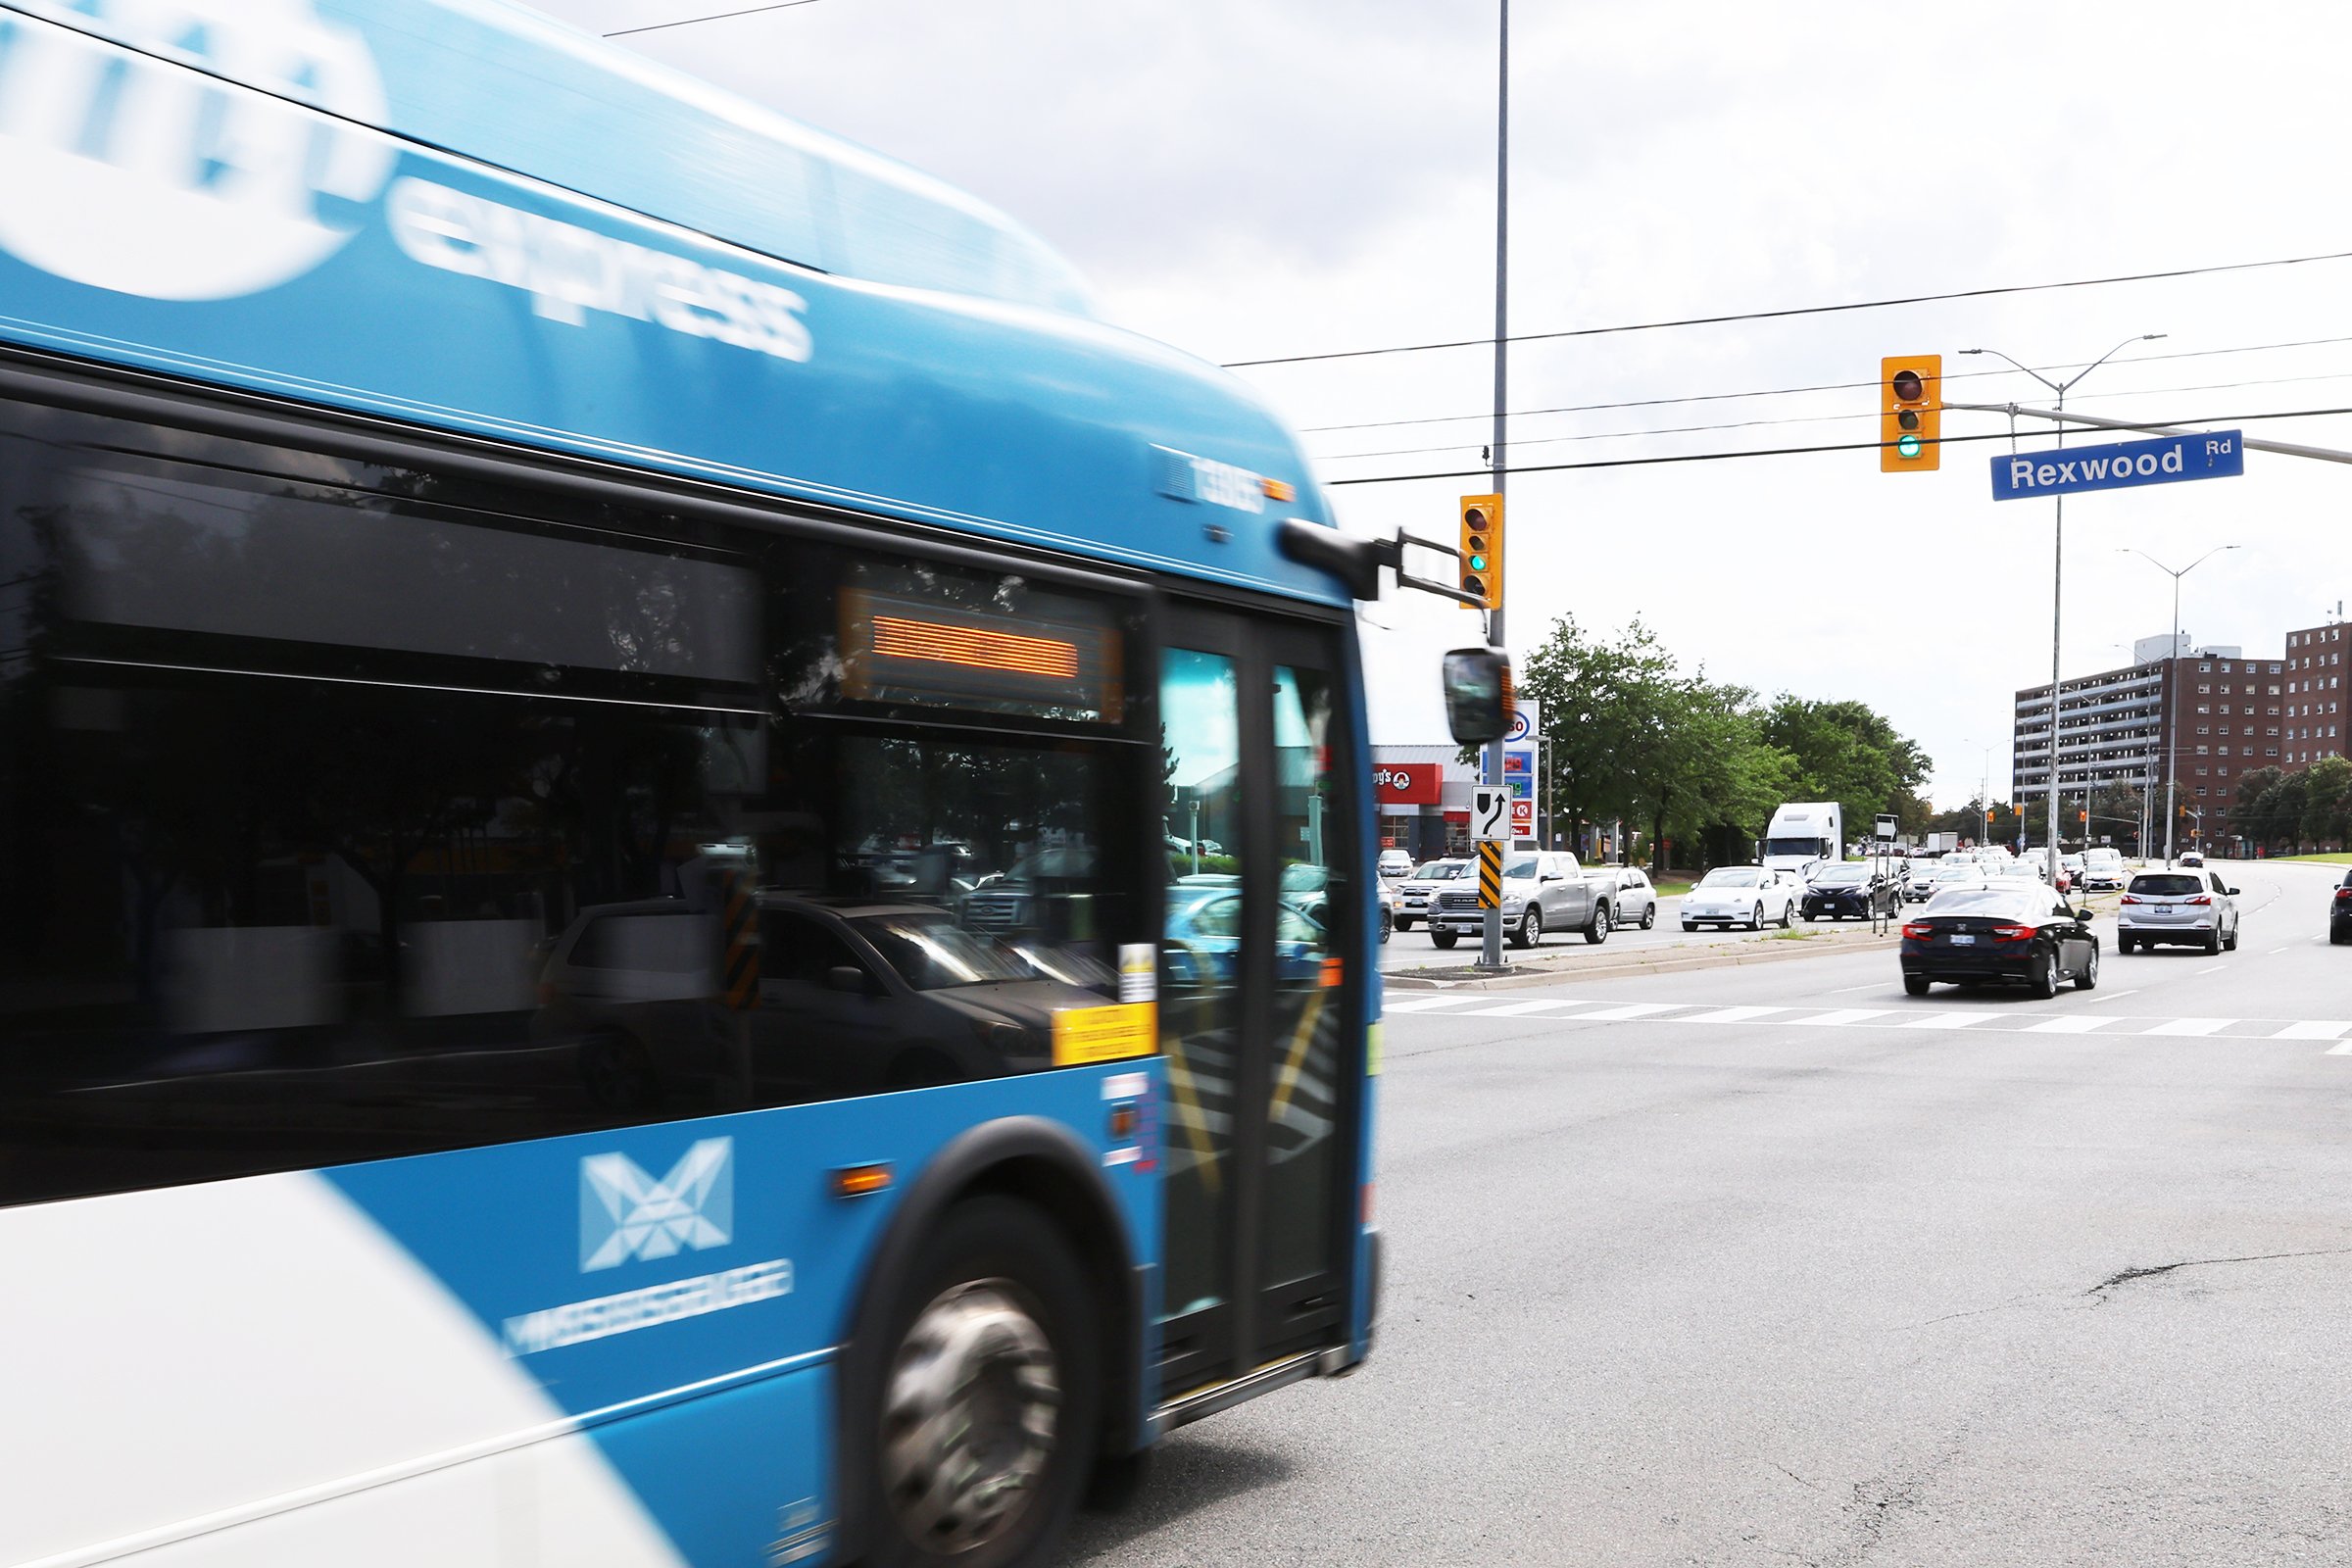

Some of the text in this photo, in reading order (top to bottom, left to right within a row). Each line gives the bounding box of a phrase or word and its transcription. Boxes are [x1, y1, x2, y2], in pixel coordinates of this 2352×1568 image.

[385, 174, 814, 364] express
[2010, 439, 2231, 489] Rexwood Rd
